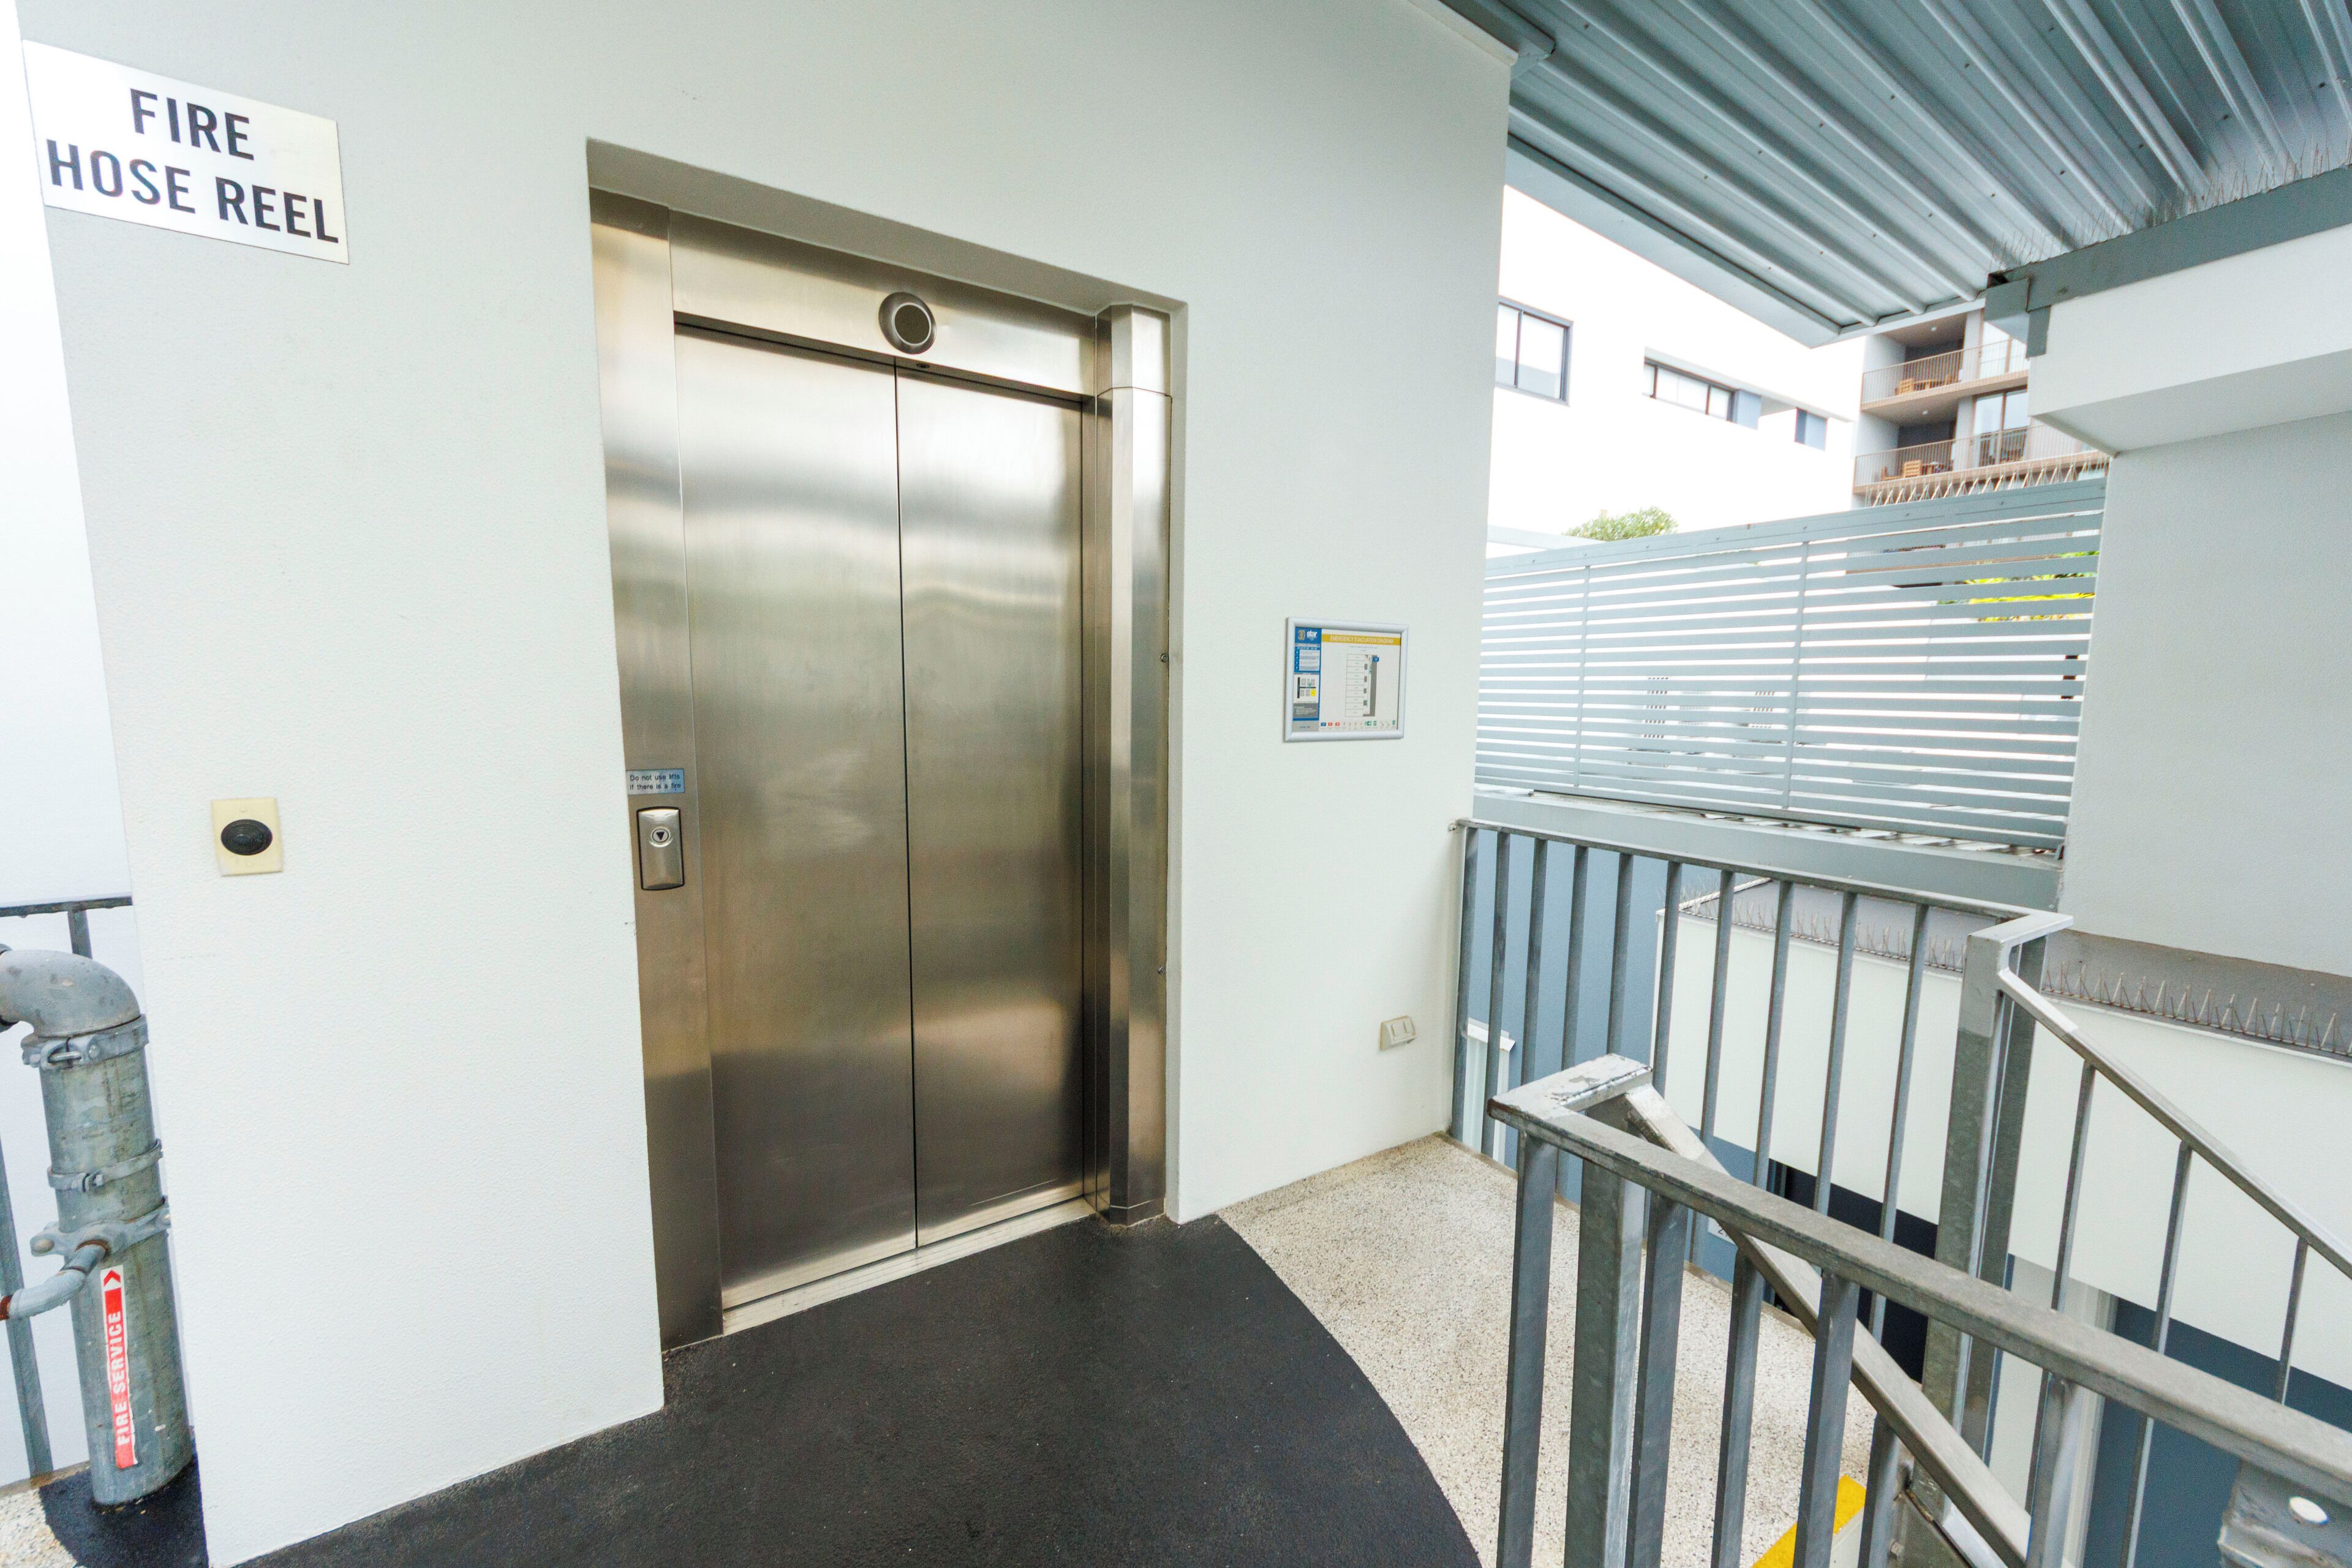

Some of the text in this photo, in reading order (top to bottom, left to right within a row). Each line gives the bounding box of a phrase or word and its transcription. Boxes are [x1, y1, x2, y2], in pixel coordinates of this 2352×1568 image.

[129, 88, 255, 161] FIRE
[46, 139, 339, 244] HOSE REEL
[108, 1311, 130, 1447] FIRE SERVICE
